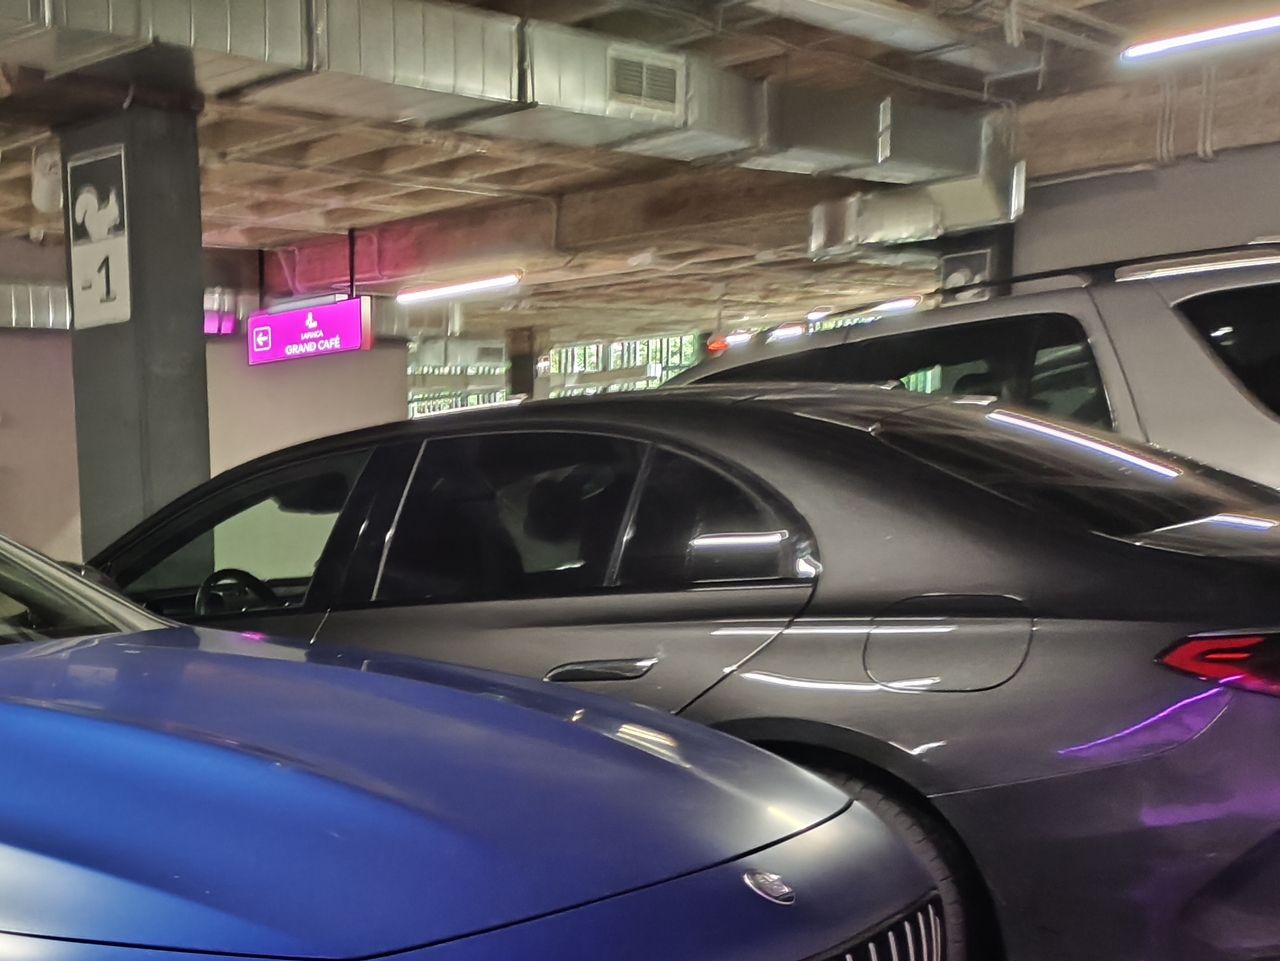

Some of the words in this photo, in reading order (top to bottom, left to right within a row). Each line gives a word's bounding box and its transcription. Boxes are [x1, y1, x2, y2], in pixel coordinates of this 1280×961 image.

[82, 255, 117, 304] -1
[285, 341, 317, 356] GRAND
[317, 334, 341, 350] CAFÉ
